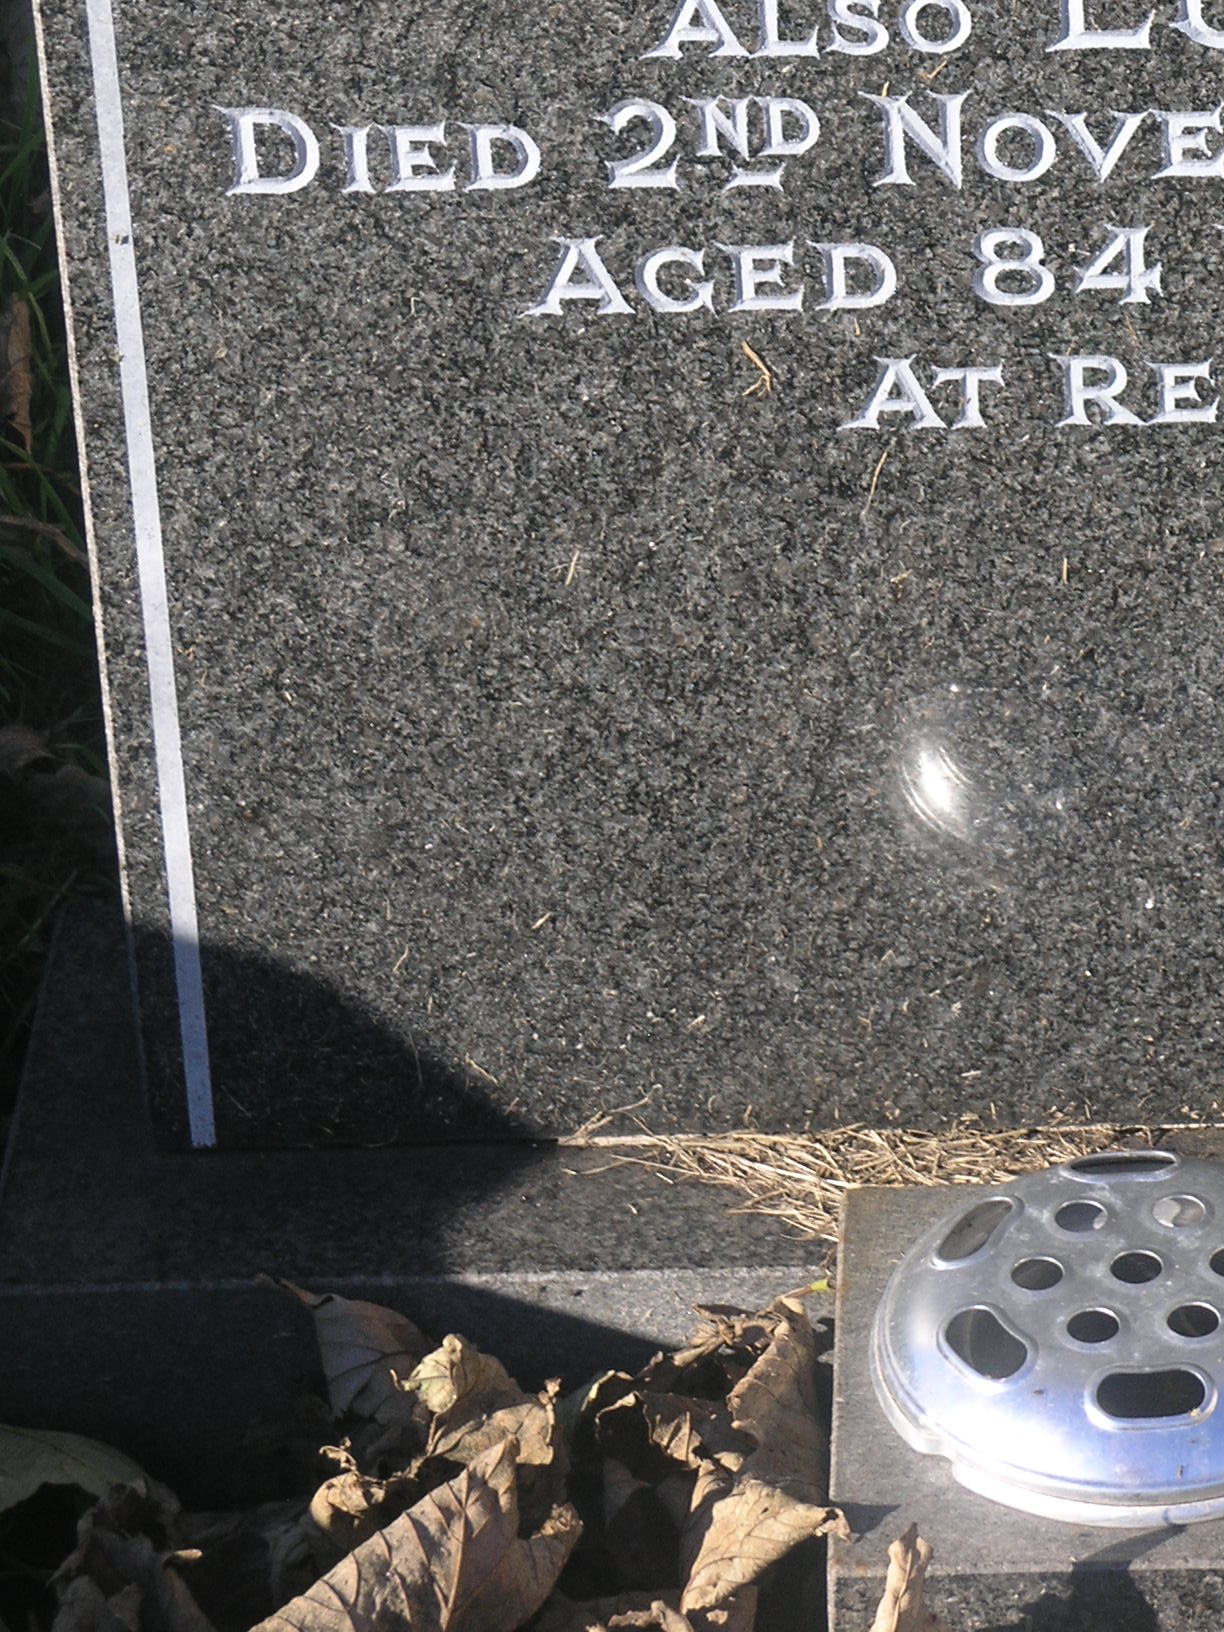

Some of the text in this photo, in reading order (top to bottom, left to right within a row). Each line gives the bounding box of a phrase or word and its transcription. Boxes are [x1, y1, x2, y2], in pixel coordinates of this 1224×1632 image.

[212, 104, 543, 196] DIED
[599, 97, 822, 191] 2ND
[518, 235, 900, 318] AGED
[972, 226, 1164, 307] 84
[838, 356, 1004, 431] AT
